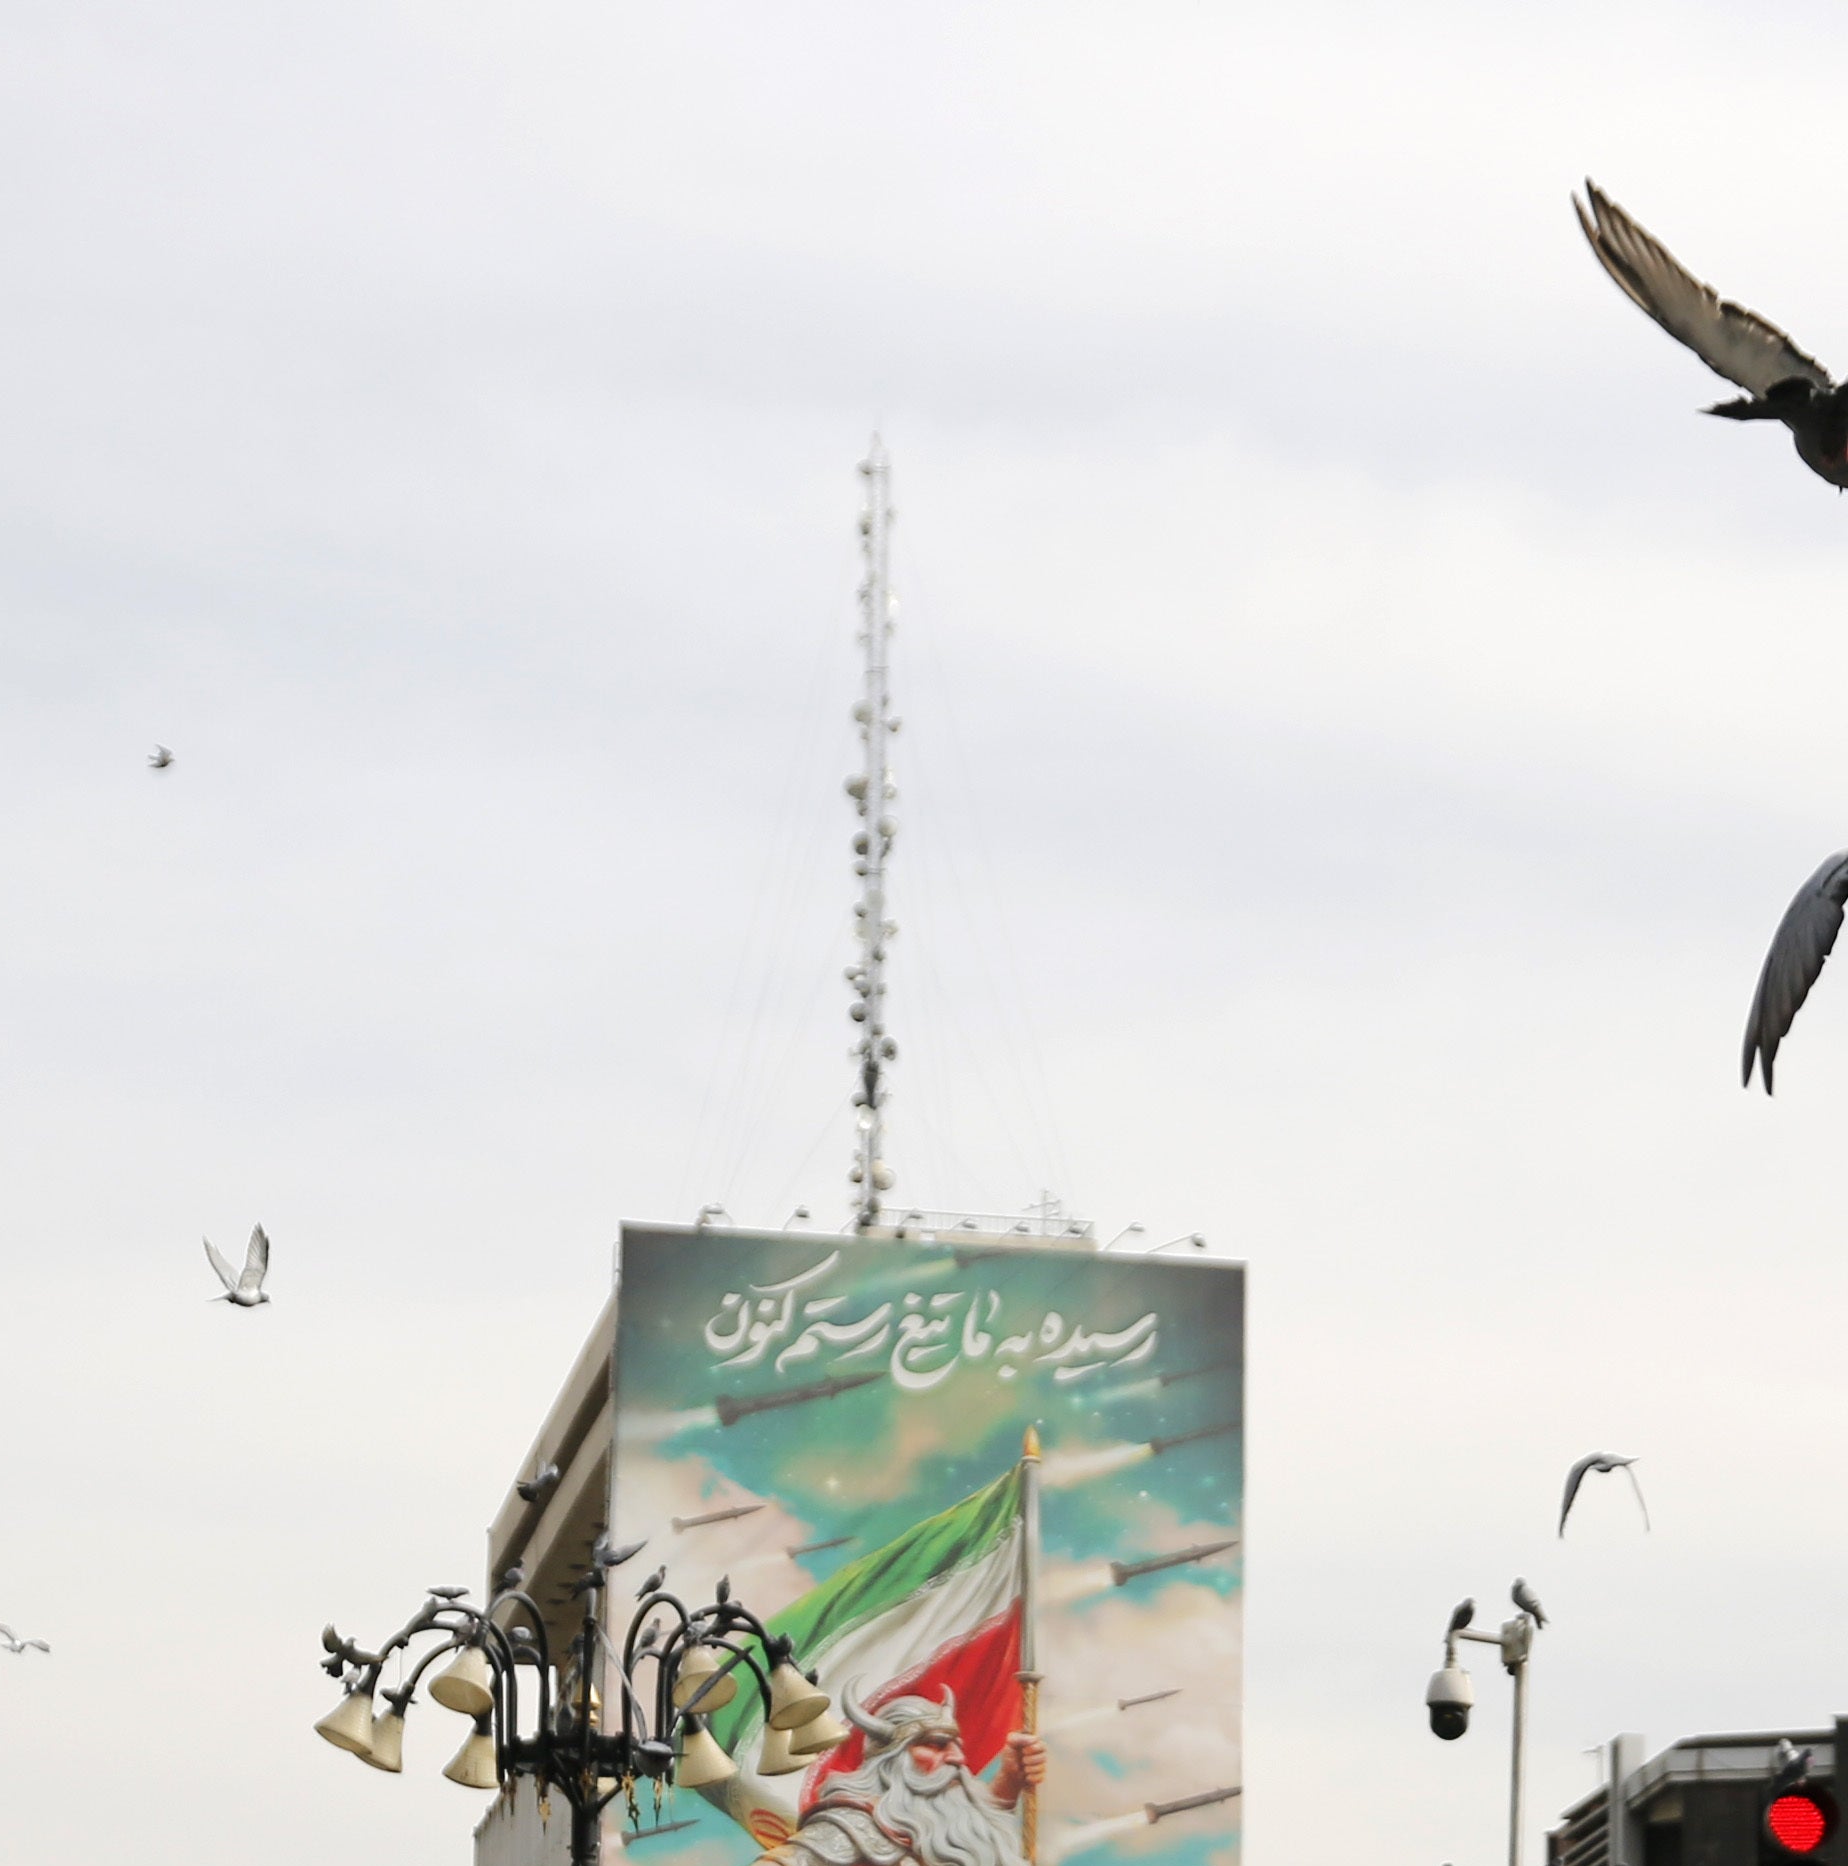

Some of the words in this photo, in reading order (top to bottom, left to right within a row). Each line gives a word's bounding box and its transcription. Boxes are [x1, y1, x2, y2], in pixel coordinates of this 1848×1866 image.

[773, 1295, 893, 1375] رستم
[994, 1327, 1035, 1379] به
[1033, 1311, 1158, 1381] رسیده
